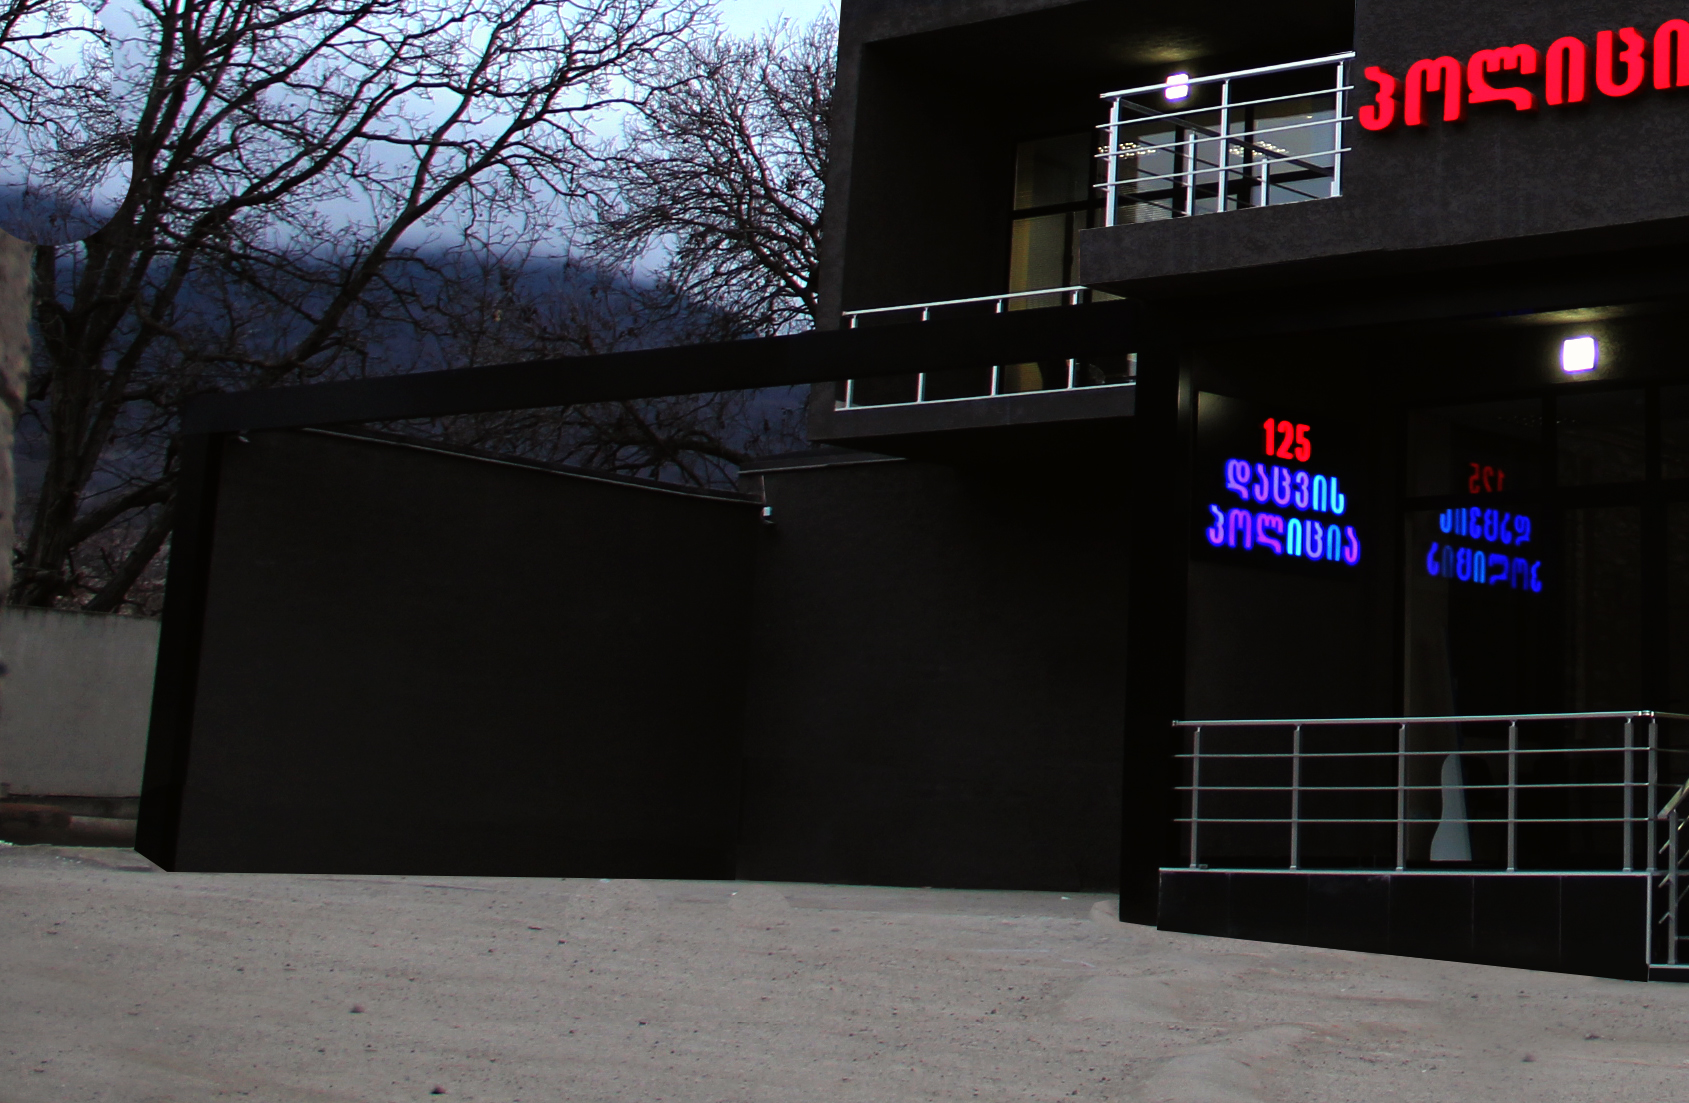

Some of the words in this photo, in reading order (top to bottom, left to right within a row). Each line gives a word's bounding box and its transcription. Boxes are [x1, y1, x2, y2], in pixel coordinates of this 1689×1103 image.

[1262, 416, 1312, 463] 125
[1224, 457, 1347, 516] დაცვის
[1206, 503, 1362, 566] პოლიცია
